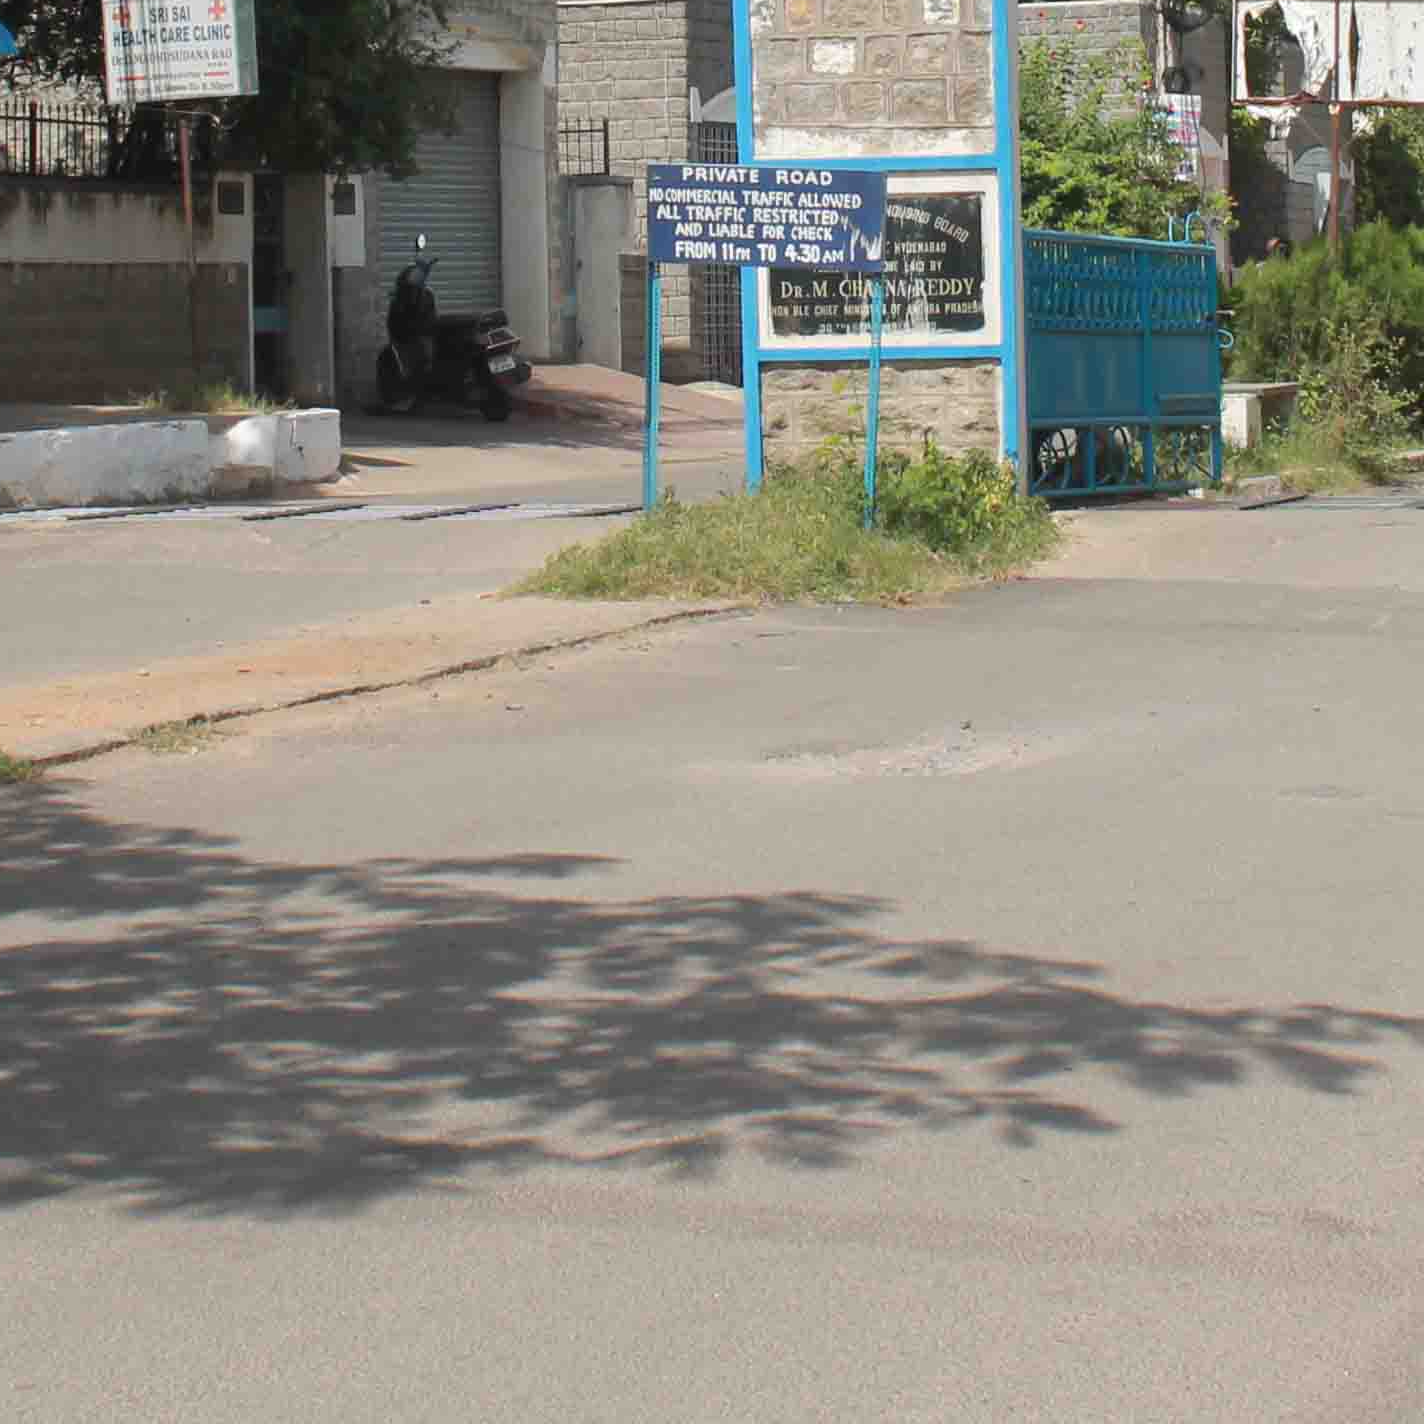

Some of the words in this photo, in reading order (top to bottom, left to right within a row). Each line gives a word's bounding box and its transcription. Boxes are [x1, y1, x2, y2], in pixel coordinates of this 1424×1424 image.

[149, 7, 169, 24] SRI
[171, 6, 191, 23] SAI
[113, 28, 158, 47] HEALTH
[159, 26, 191, 44] CARE
[192, 23, 232, 42] CLINIC
[682, 167, 760, 184] PRIVATE
[776, 170, 832, 186] ROAD
[649, 188, 664, 203] NO
[665, 188, 738, 205] COMMERCIAL
[742, 190, 794, 207] TRAFFIC
[798, 193, 862, 209] ALLOWED
[656, 205, 681, 220] ALL
[686, 206, 744, 223] TRAFFIC
[753, 208, 839, 225] RESTRICTED
[675, 223, 703, 237] AND
[709, 224, 754, 239] LIABLE
[763, 225, 785, 240] FOR
[791, 226, 833, 241] CHECK
[934, 217, 969, 243] BOARD
[675, 241, 716, 259] FROM
[757, 243, 777, 262] TO
[839, 279, 906, 296] CHANA
[914, 278, 975, 296] REDDY
